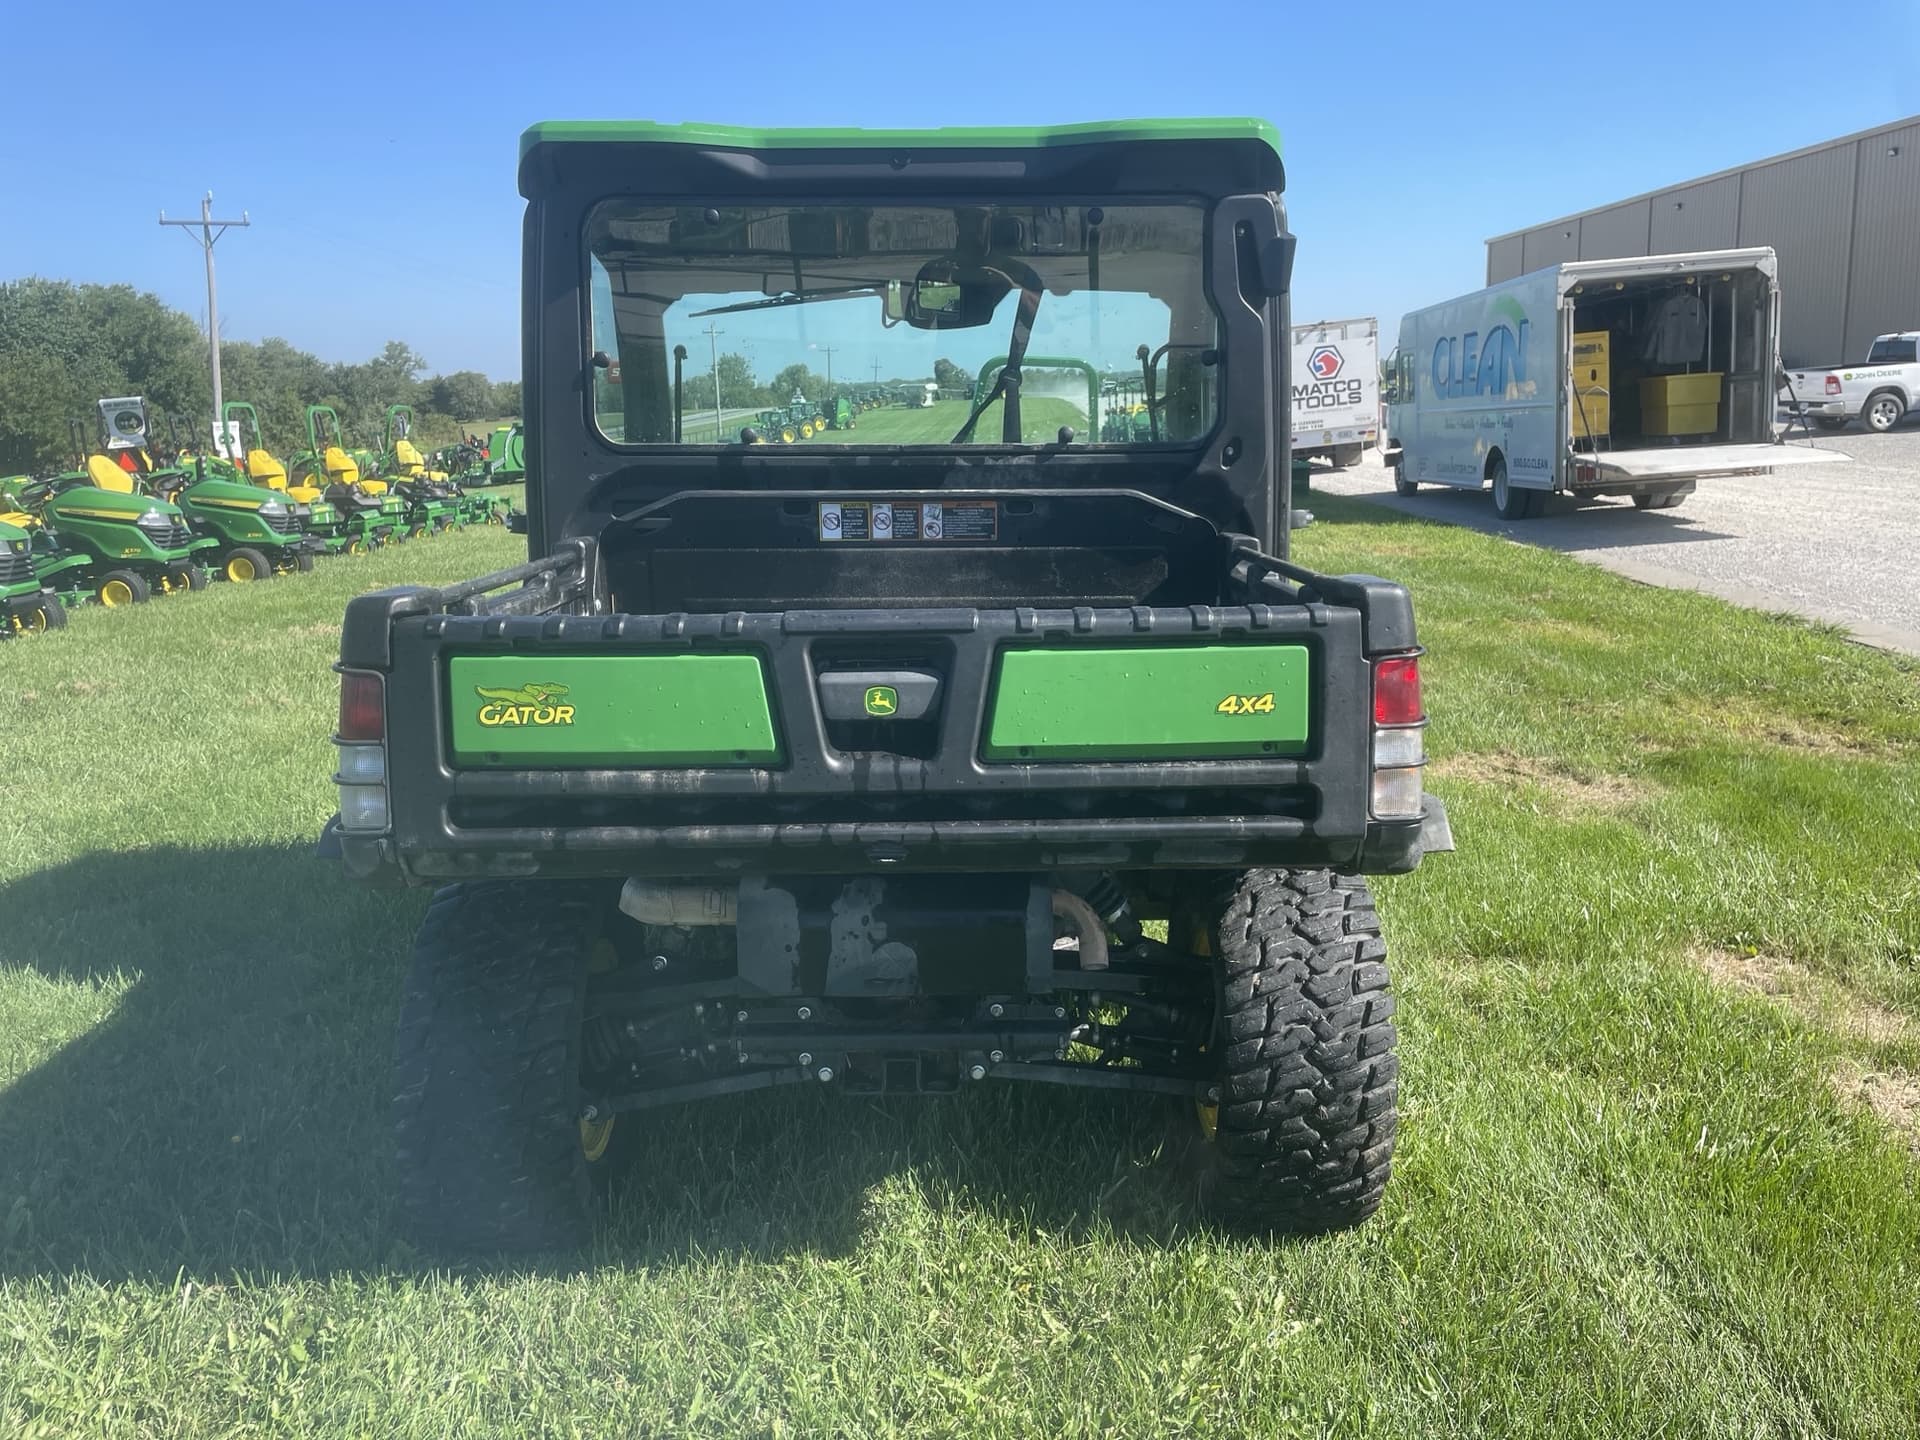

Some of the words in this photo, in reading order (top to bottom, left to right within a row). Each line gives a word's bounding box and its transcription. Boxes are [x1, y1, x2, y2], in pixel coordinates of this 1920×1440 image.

[1432, 319, 1529, 400] CLEAN
[1854, 373, 1876, 381] JOHN
[1292, 379, 1361, 398] MATCO
[1292, 392, 1361, 410] TOOLS
[477, 704, 575, 726] GATOR
